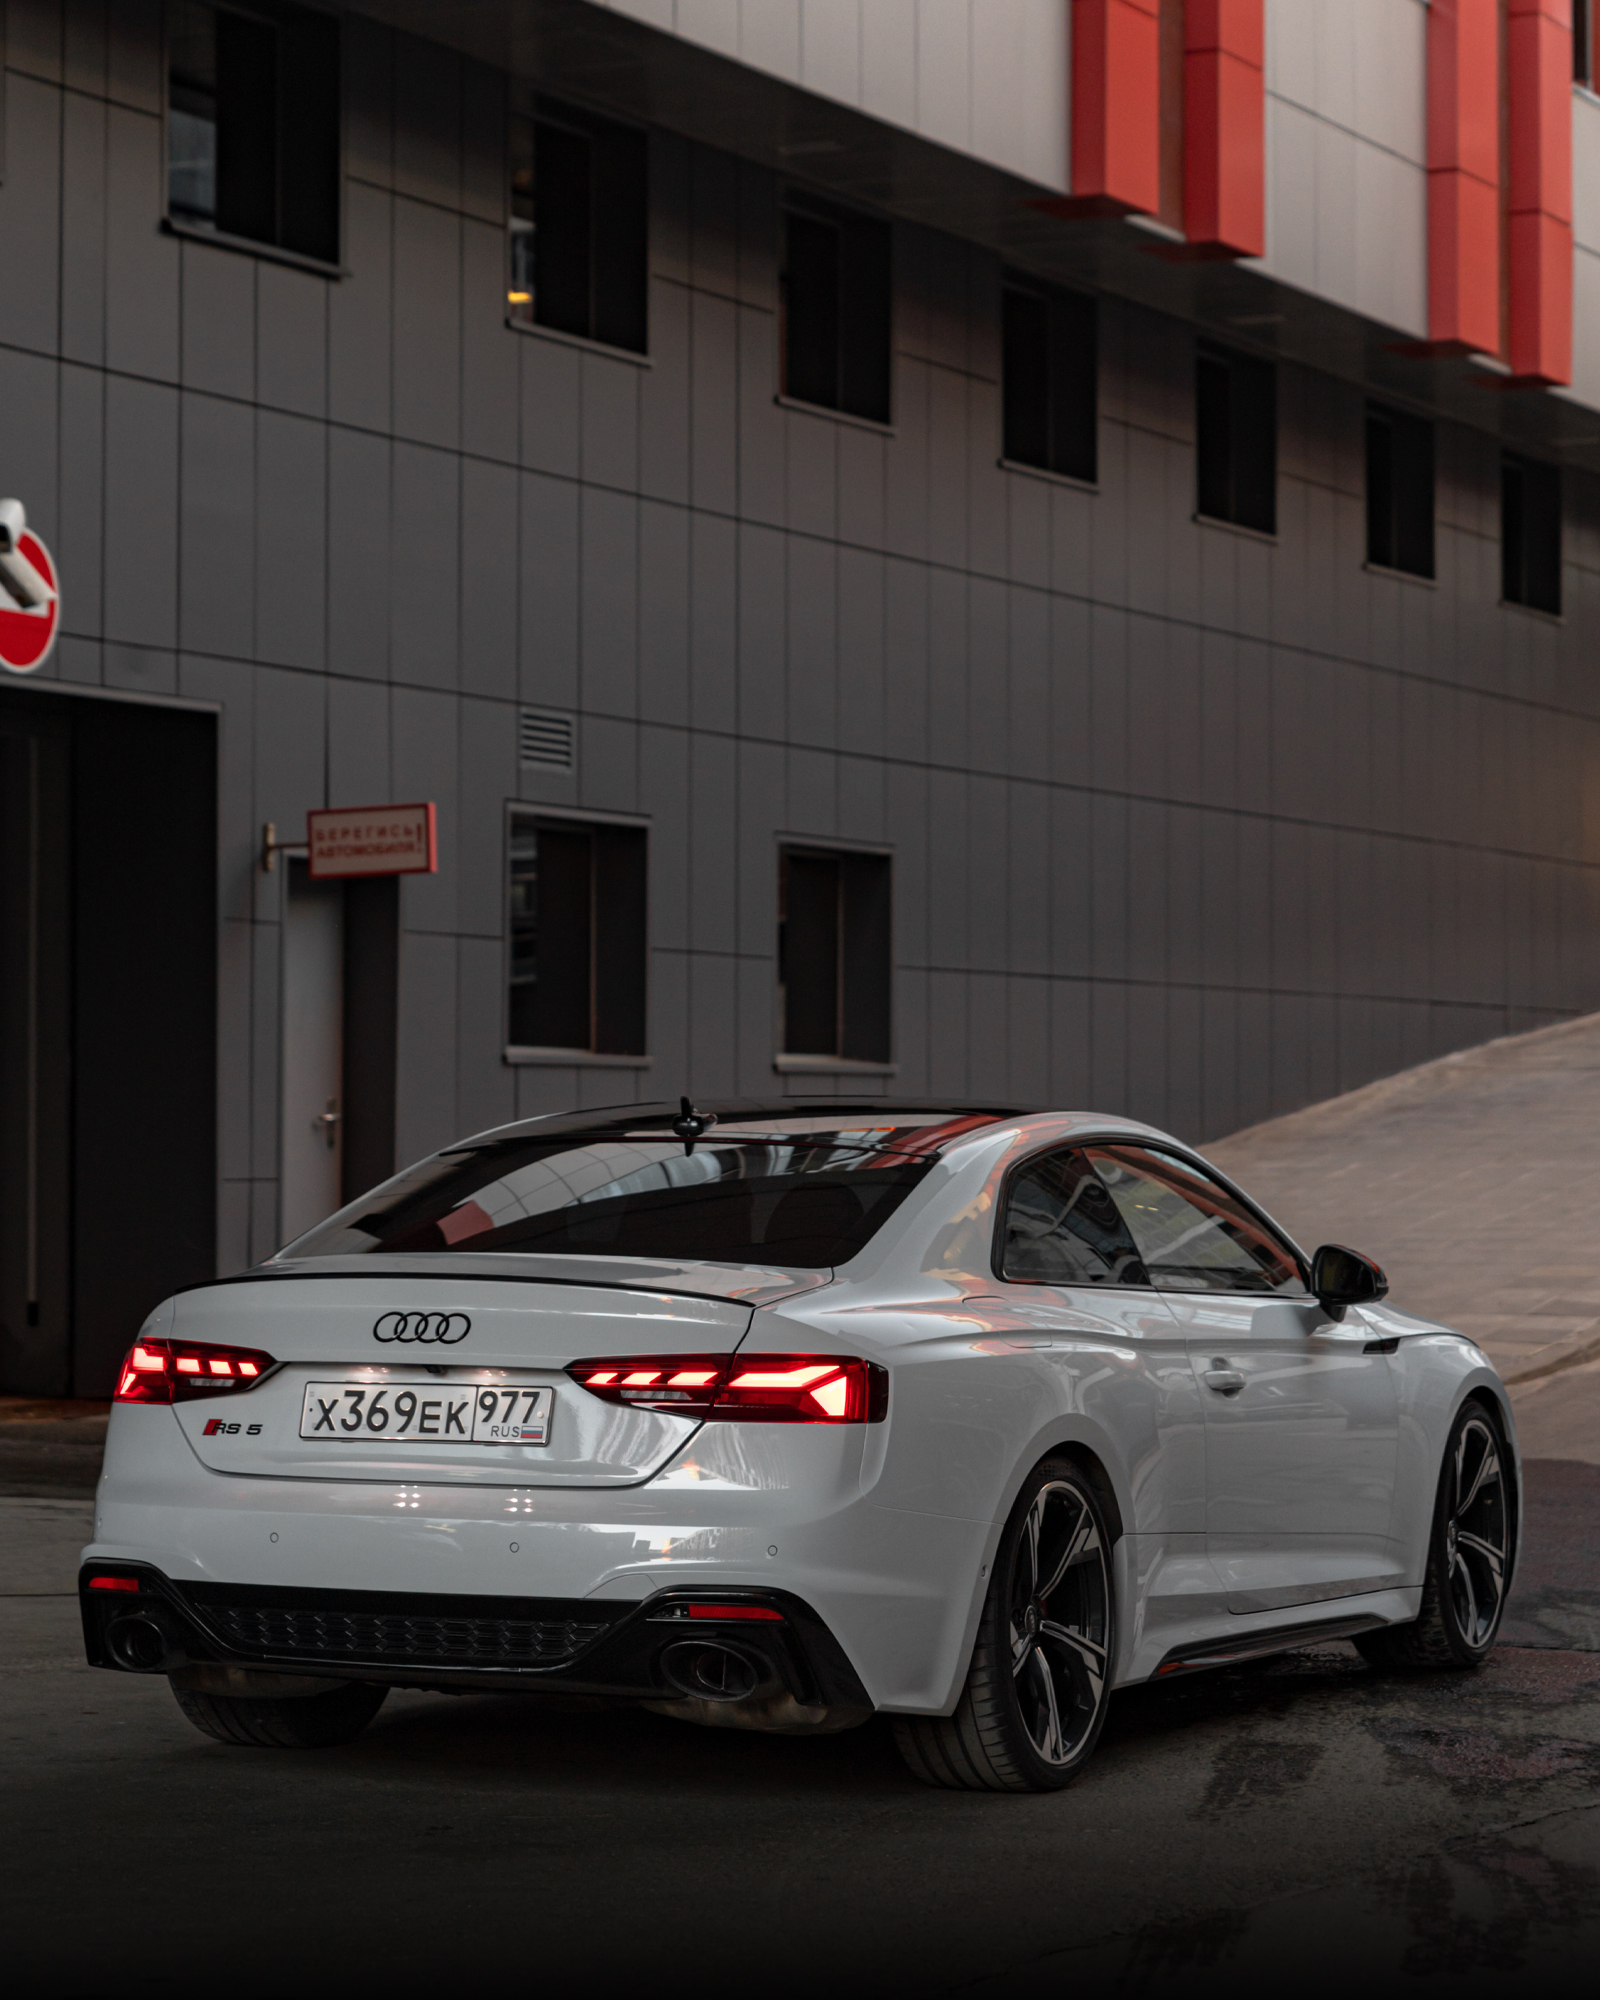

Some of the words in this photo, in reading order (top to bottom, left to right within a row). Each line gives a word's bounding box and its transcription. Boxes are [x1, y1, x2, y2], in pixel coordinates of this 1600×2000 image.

[479, 1390, 540, 1424] 977
[210, 1422, 241, 1435] RS
[246, 1424, 263, 1435] 5
[490, 1425, 520, 1438] RUS
